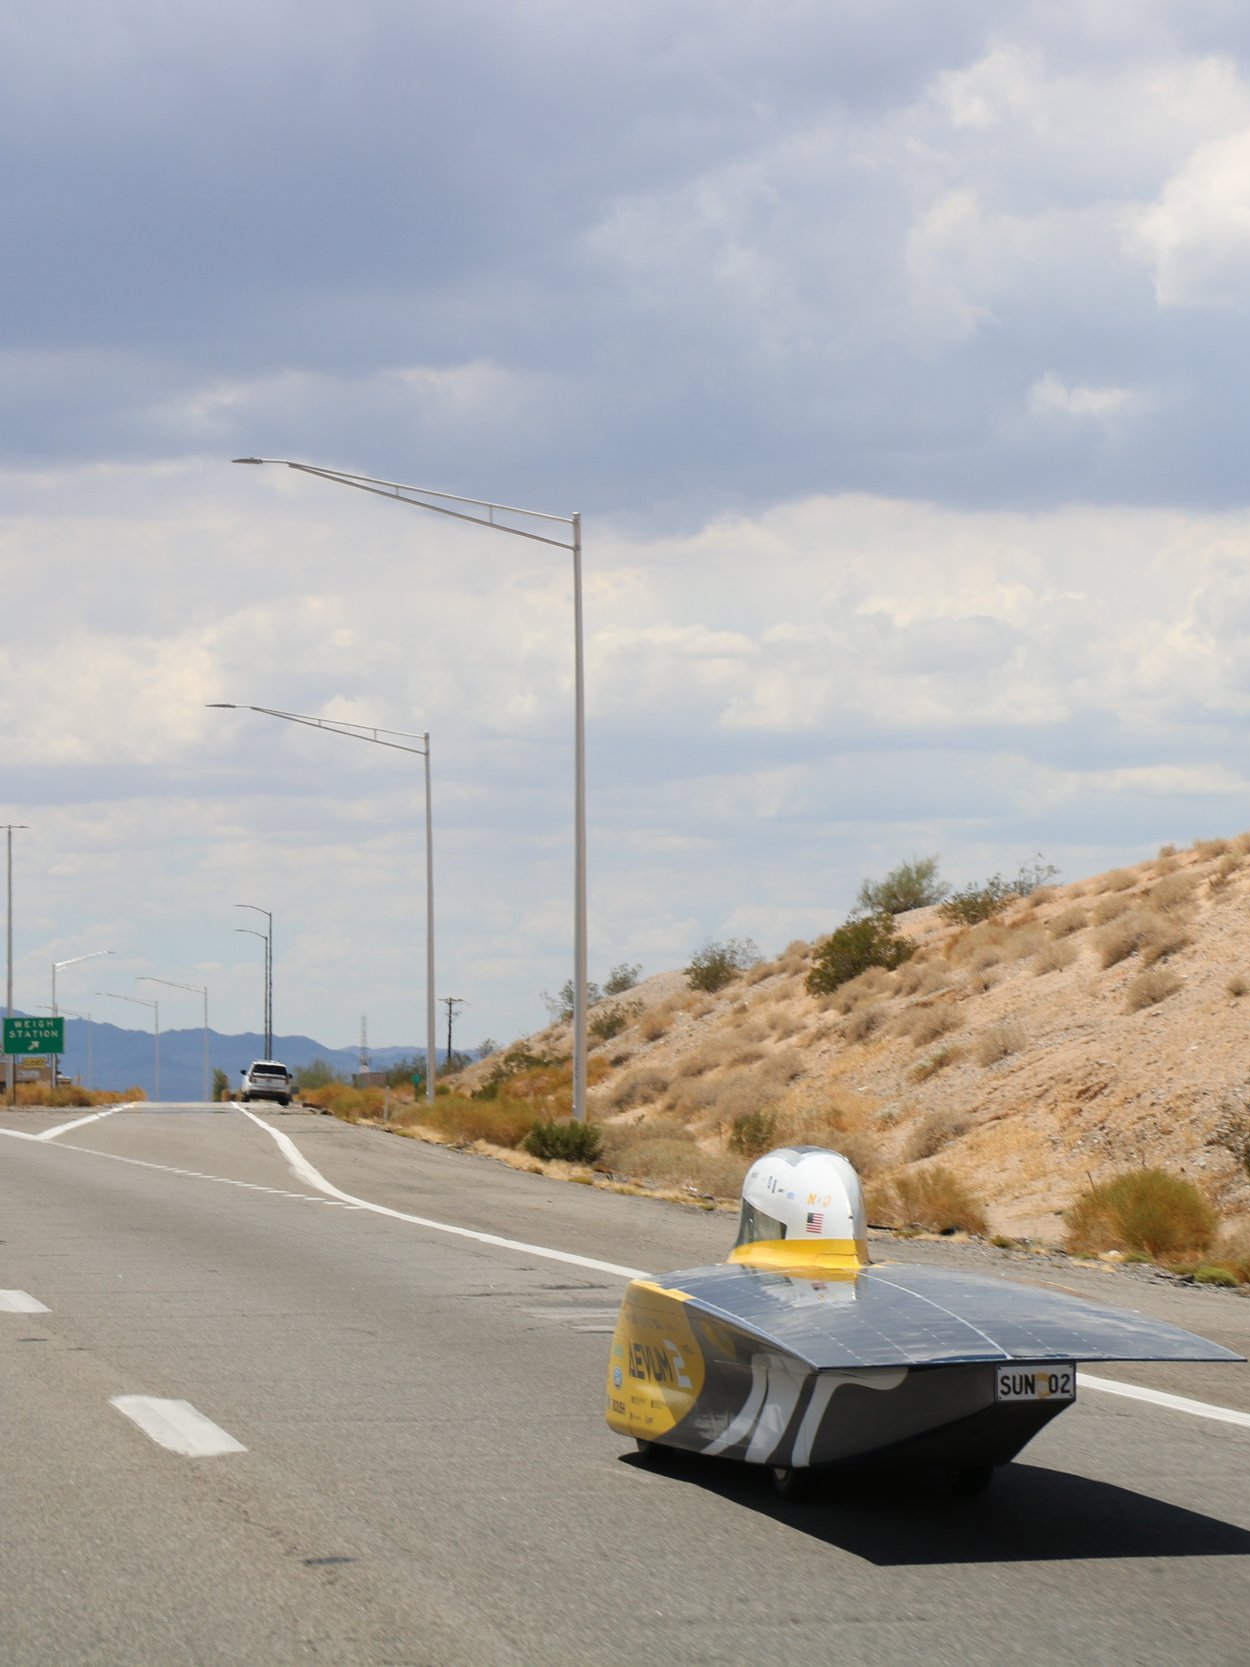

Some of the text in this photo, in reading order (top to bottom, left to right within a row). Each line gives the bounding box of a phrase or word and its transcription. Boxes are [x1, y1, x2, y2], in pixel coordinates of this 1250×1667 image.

[14, 1020, 54, 1028] WEIGH
[9, 1030, 58, 1039] STATION
[1000, 1373, 1071, 1396] SUN 02
